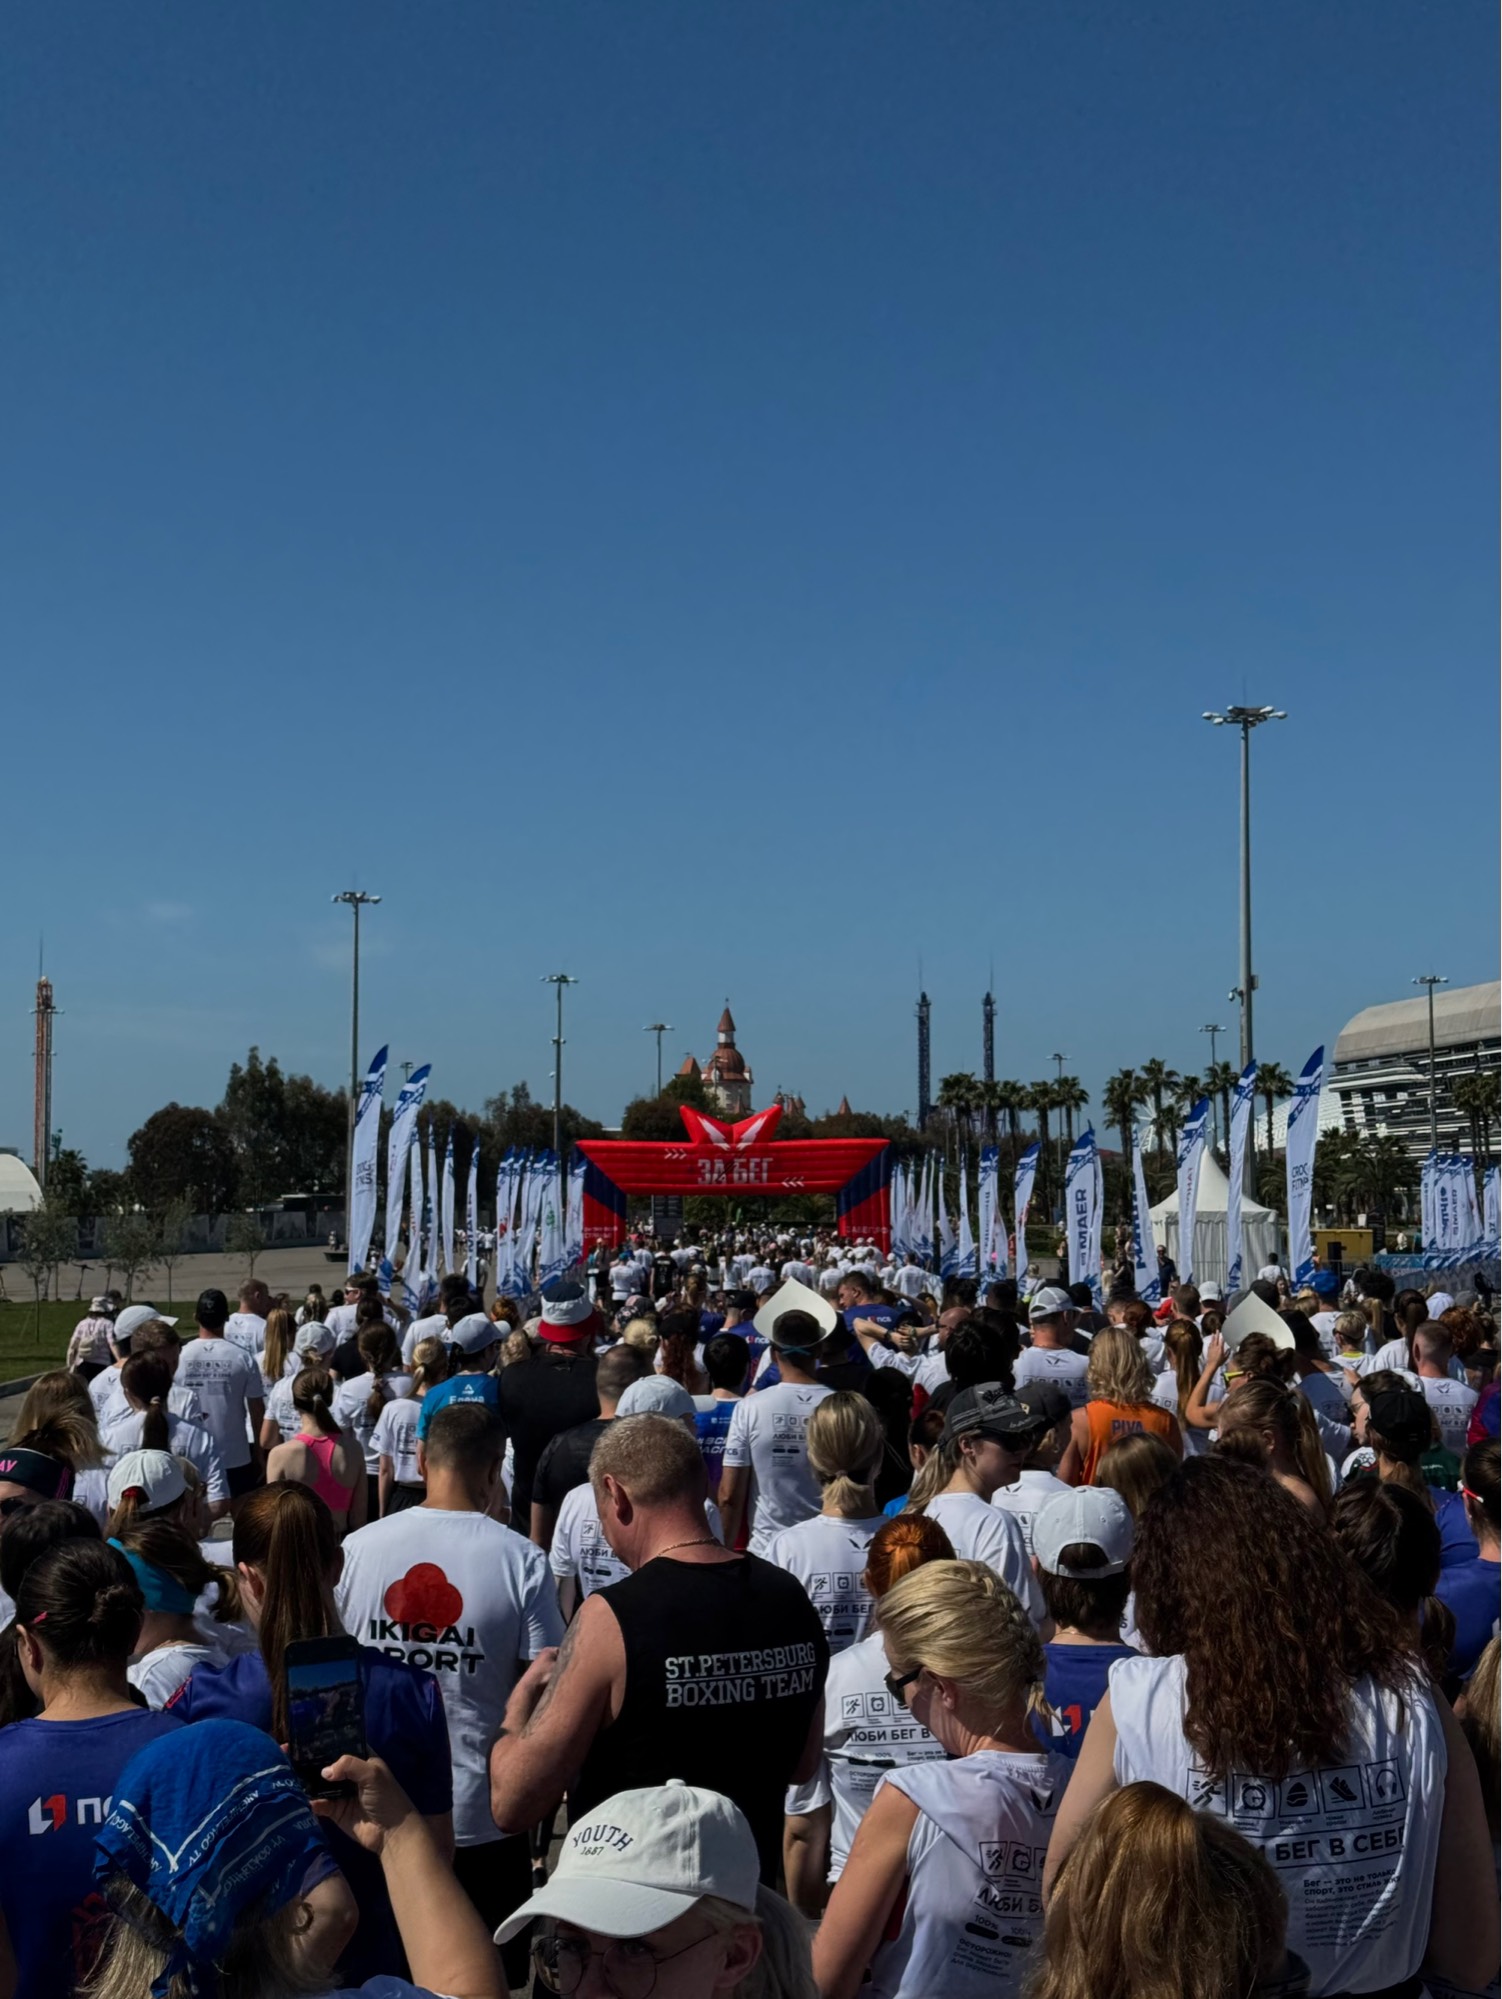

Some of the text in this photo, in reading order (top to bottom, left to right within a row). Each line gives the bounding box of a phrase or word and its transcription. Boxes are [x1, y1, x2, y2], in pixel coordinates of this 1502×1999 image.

[1075, 1188, 1089, 1250] MAER
[819, 1604, 848, 1614] ЮБИ
[371, 1620, 475, 1647] IKIGAI
[370, 1646, 485, 1674] PORT
[665, 1642, 817, 1679] ST.PETERSBURG
[665, 1668, 815, 1708] BOXING TEAM
[891, 1728, 917, 1740] БЕГ
[921, 1728, 931, 1739] В
[573, 1824, 634, 1852] YOUTH
[1276, 1840, 1320, 1861] БЕГ
[1330, 1838, 1345, 1856] В
[1304, 1880, 1321, 1888] Бег
[1304, 1886, 1336, 1896] спорт,
[1338, 1885, 1354, 1893] это
